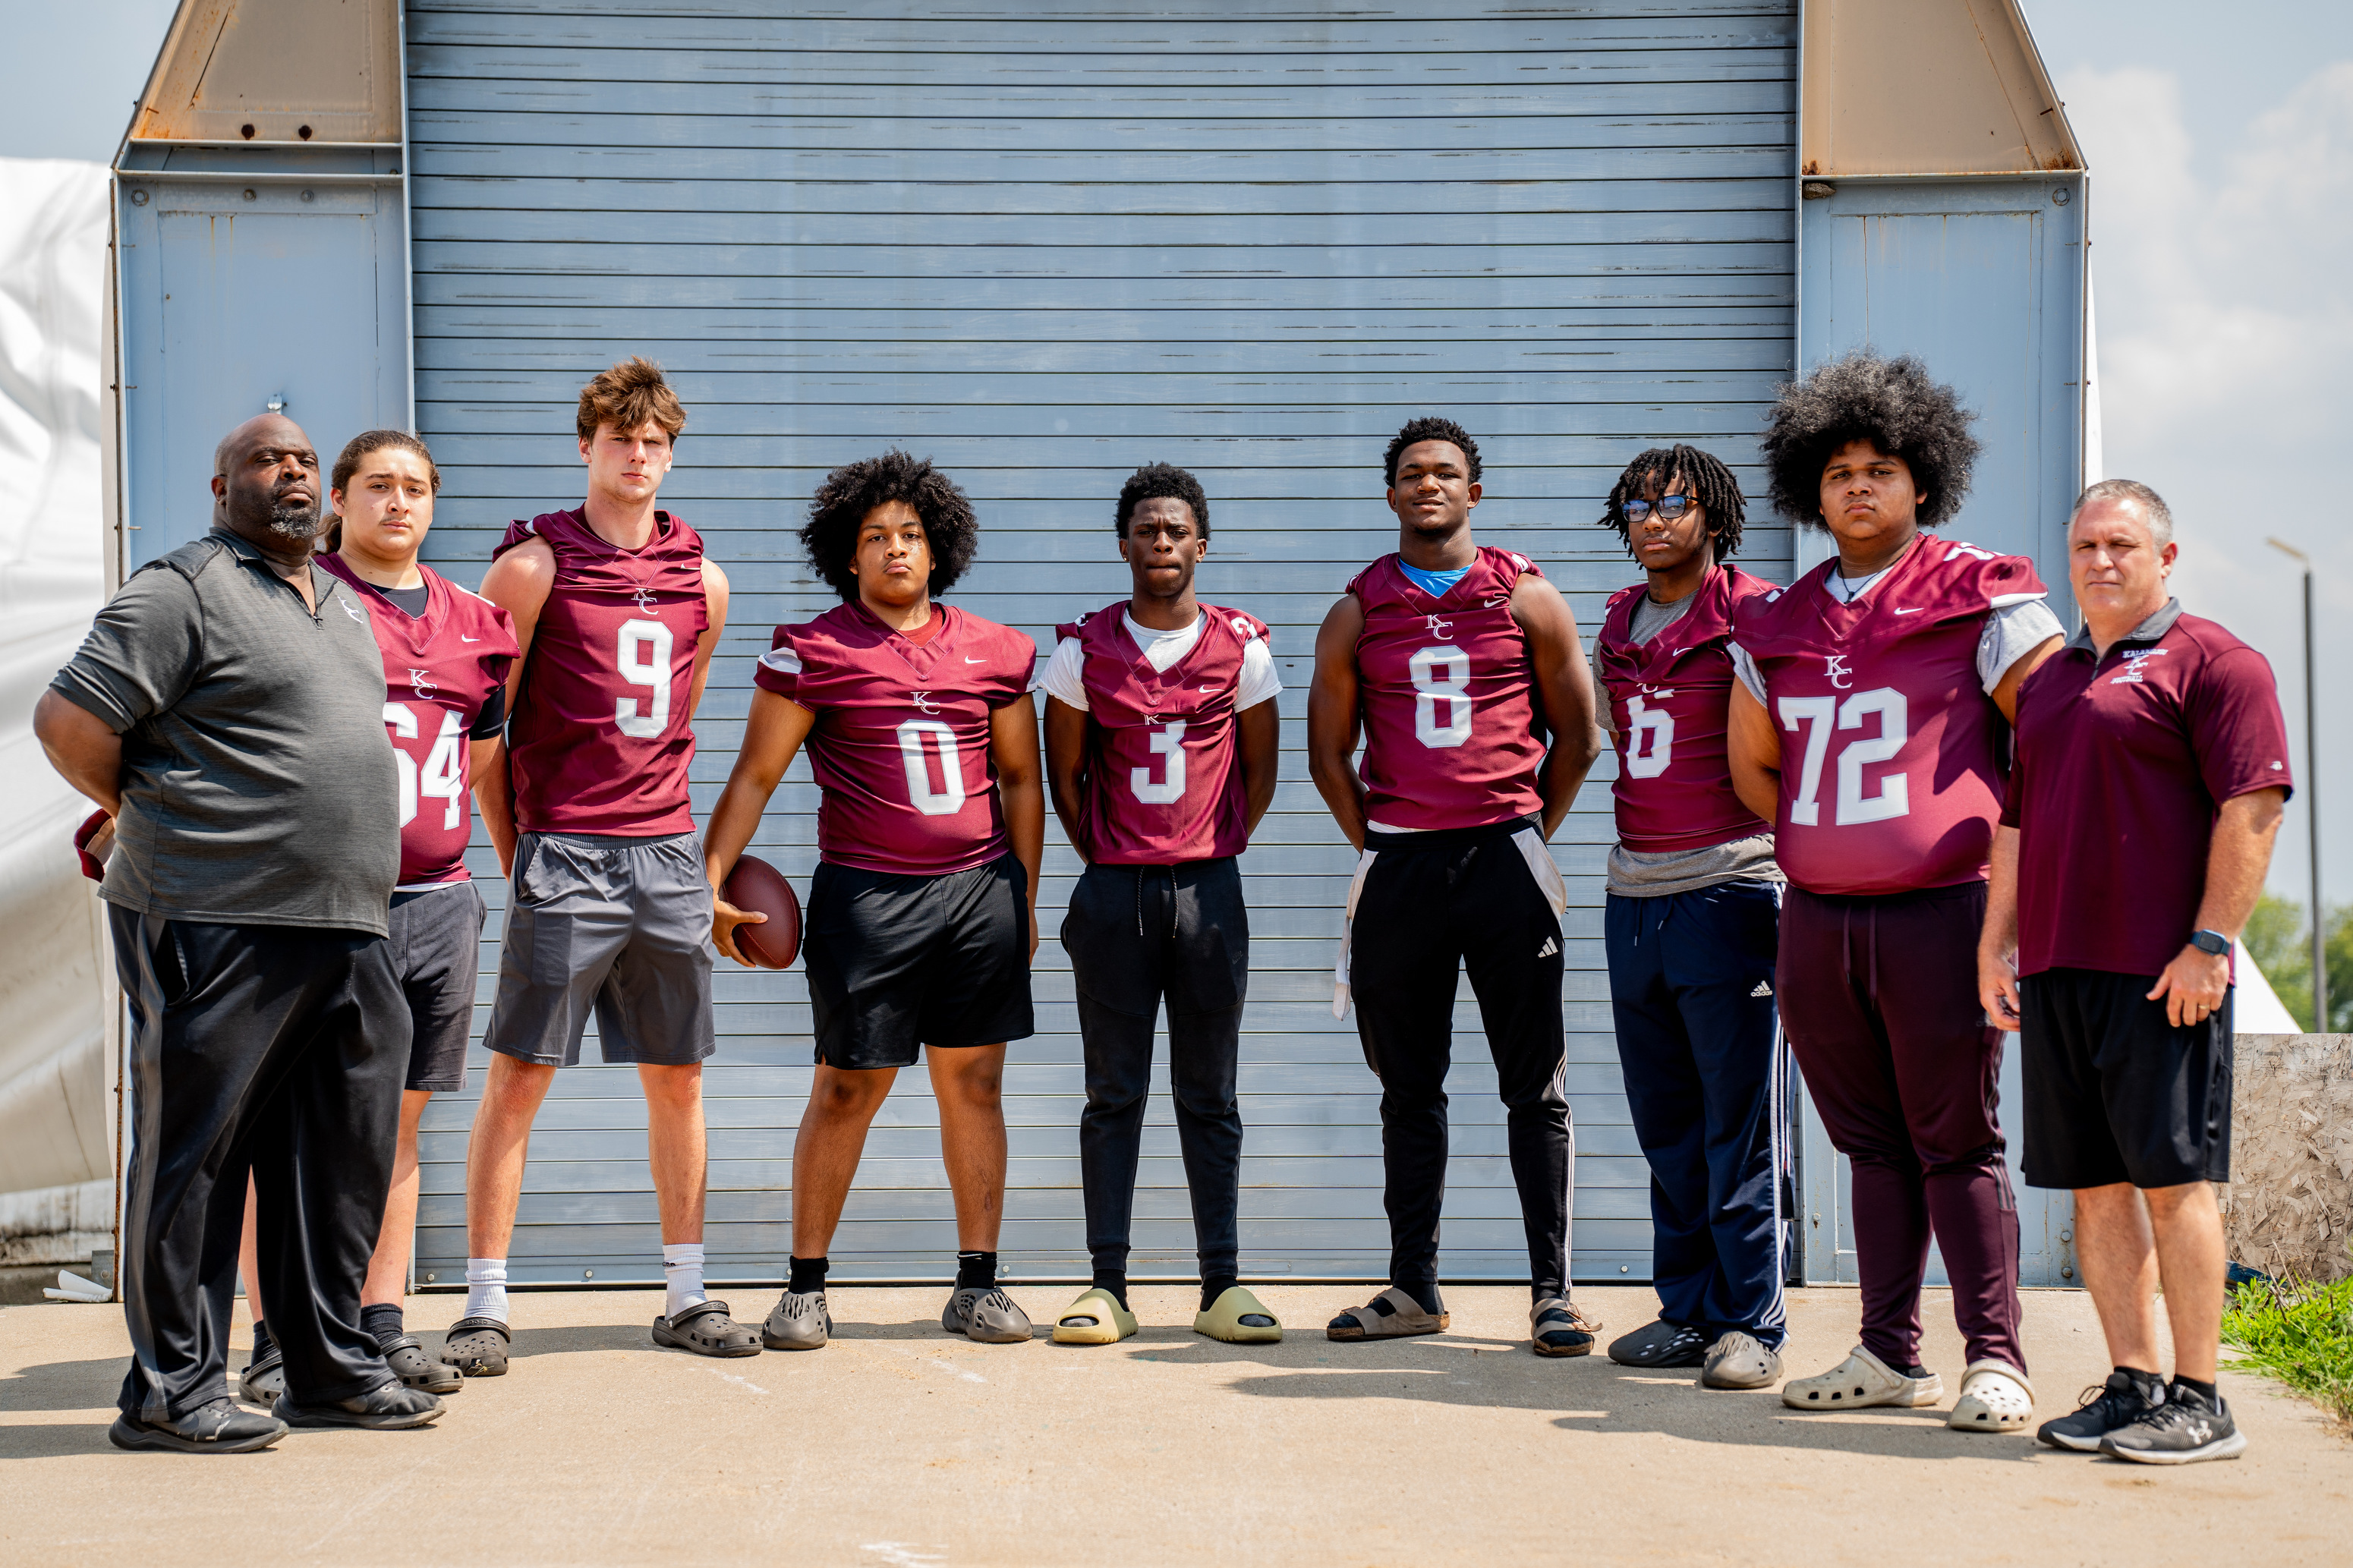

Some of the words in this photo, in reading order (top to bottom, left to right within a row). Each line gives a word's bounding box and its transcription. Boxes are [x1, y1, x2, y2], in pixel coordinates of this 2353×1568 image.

[1425, 613, 1454, 640] KC
[408, 669, 437, 699] KC
[615, 619, 673, 738] 9
[910, 691, 941, 715] KC
[1409, 645, 1472, 748] 8
[1823, 655, 1852, 689] KC
[896, 719, 965, 816] 0
[1130, 719, 1187, 804] 3
[1626, 688, 1674, 779] 6
[1778, 686, 1909, 827] 72
